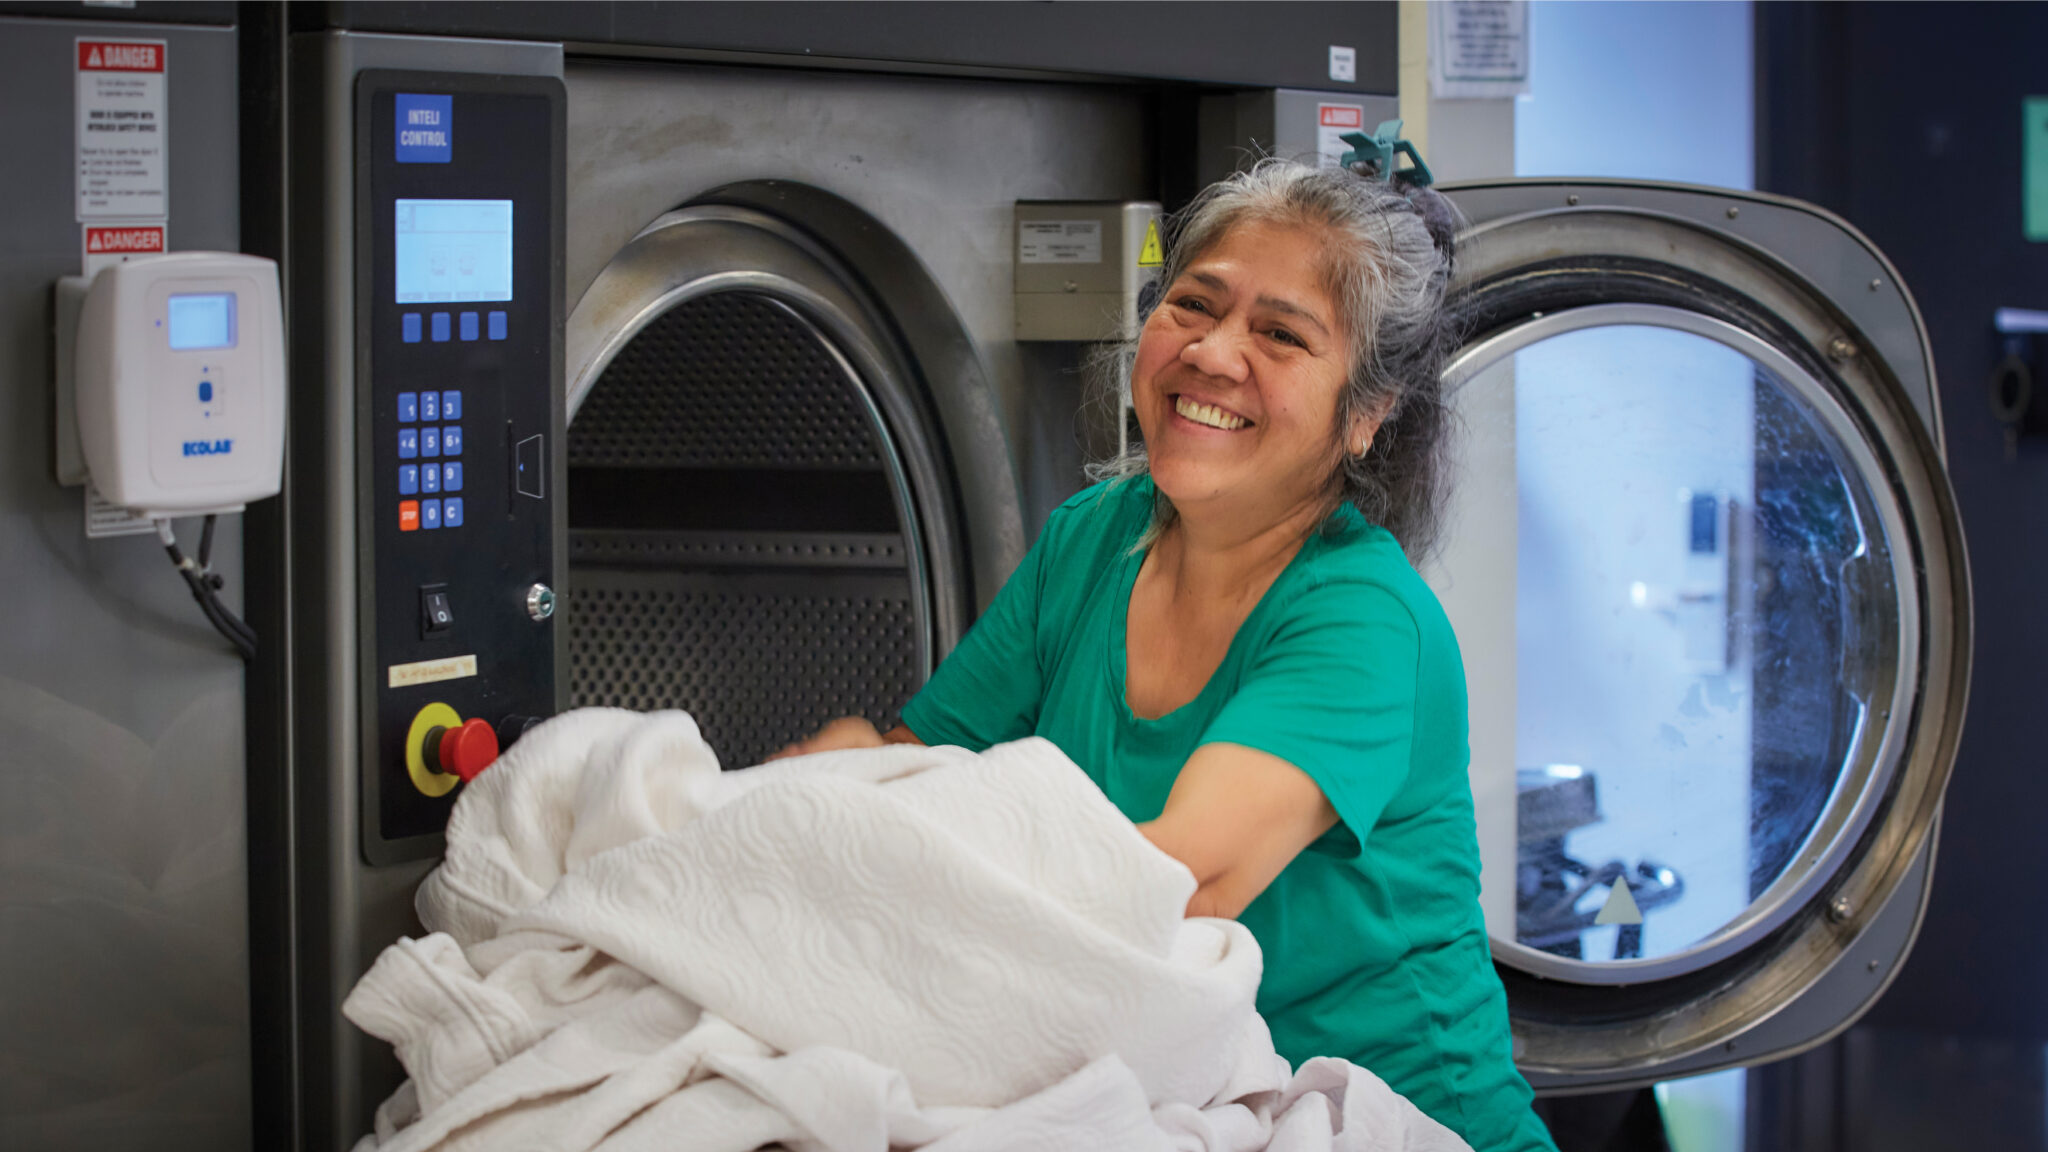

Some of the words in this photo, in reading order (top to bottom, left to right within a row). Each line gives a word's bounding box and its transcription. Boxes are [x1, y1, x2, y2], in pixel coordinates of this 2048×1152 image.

[104, 45, 156, 68] DANGER
[408, 109, 440, 125] INTELI
[400, 130, 447, 147] CONTROL
[103, 230, 161, 250] DANGER
[408, 404, 415, 417] 1
[426, 403, 435, 416] 2
[445, 402, 454, 415] 3
[183, 439, 232, 457] ECOLAB
[407, 437, 416, 449] 4
[427, 435, 435, 448] 5
[445, 434, 454, 447] 6
[408, 469, 416, 482] 7
[427, 468, 436, 481] 8
[446, 467, 455, 480] 9
[446, 506, 456, 519] C
